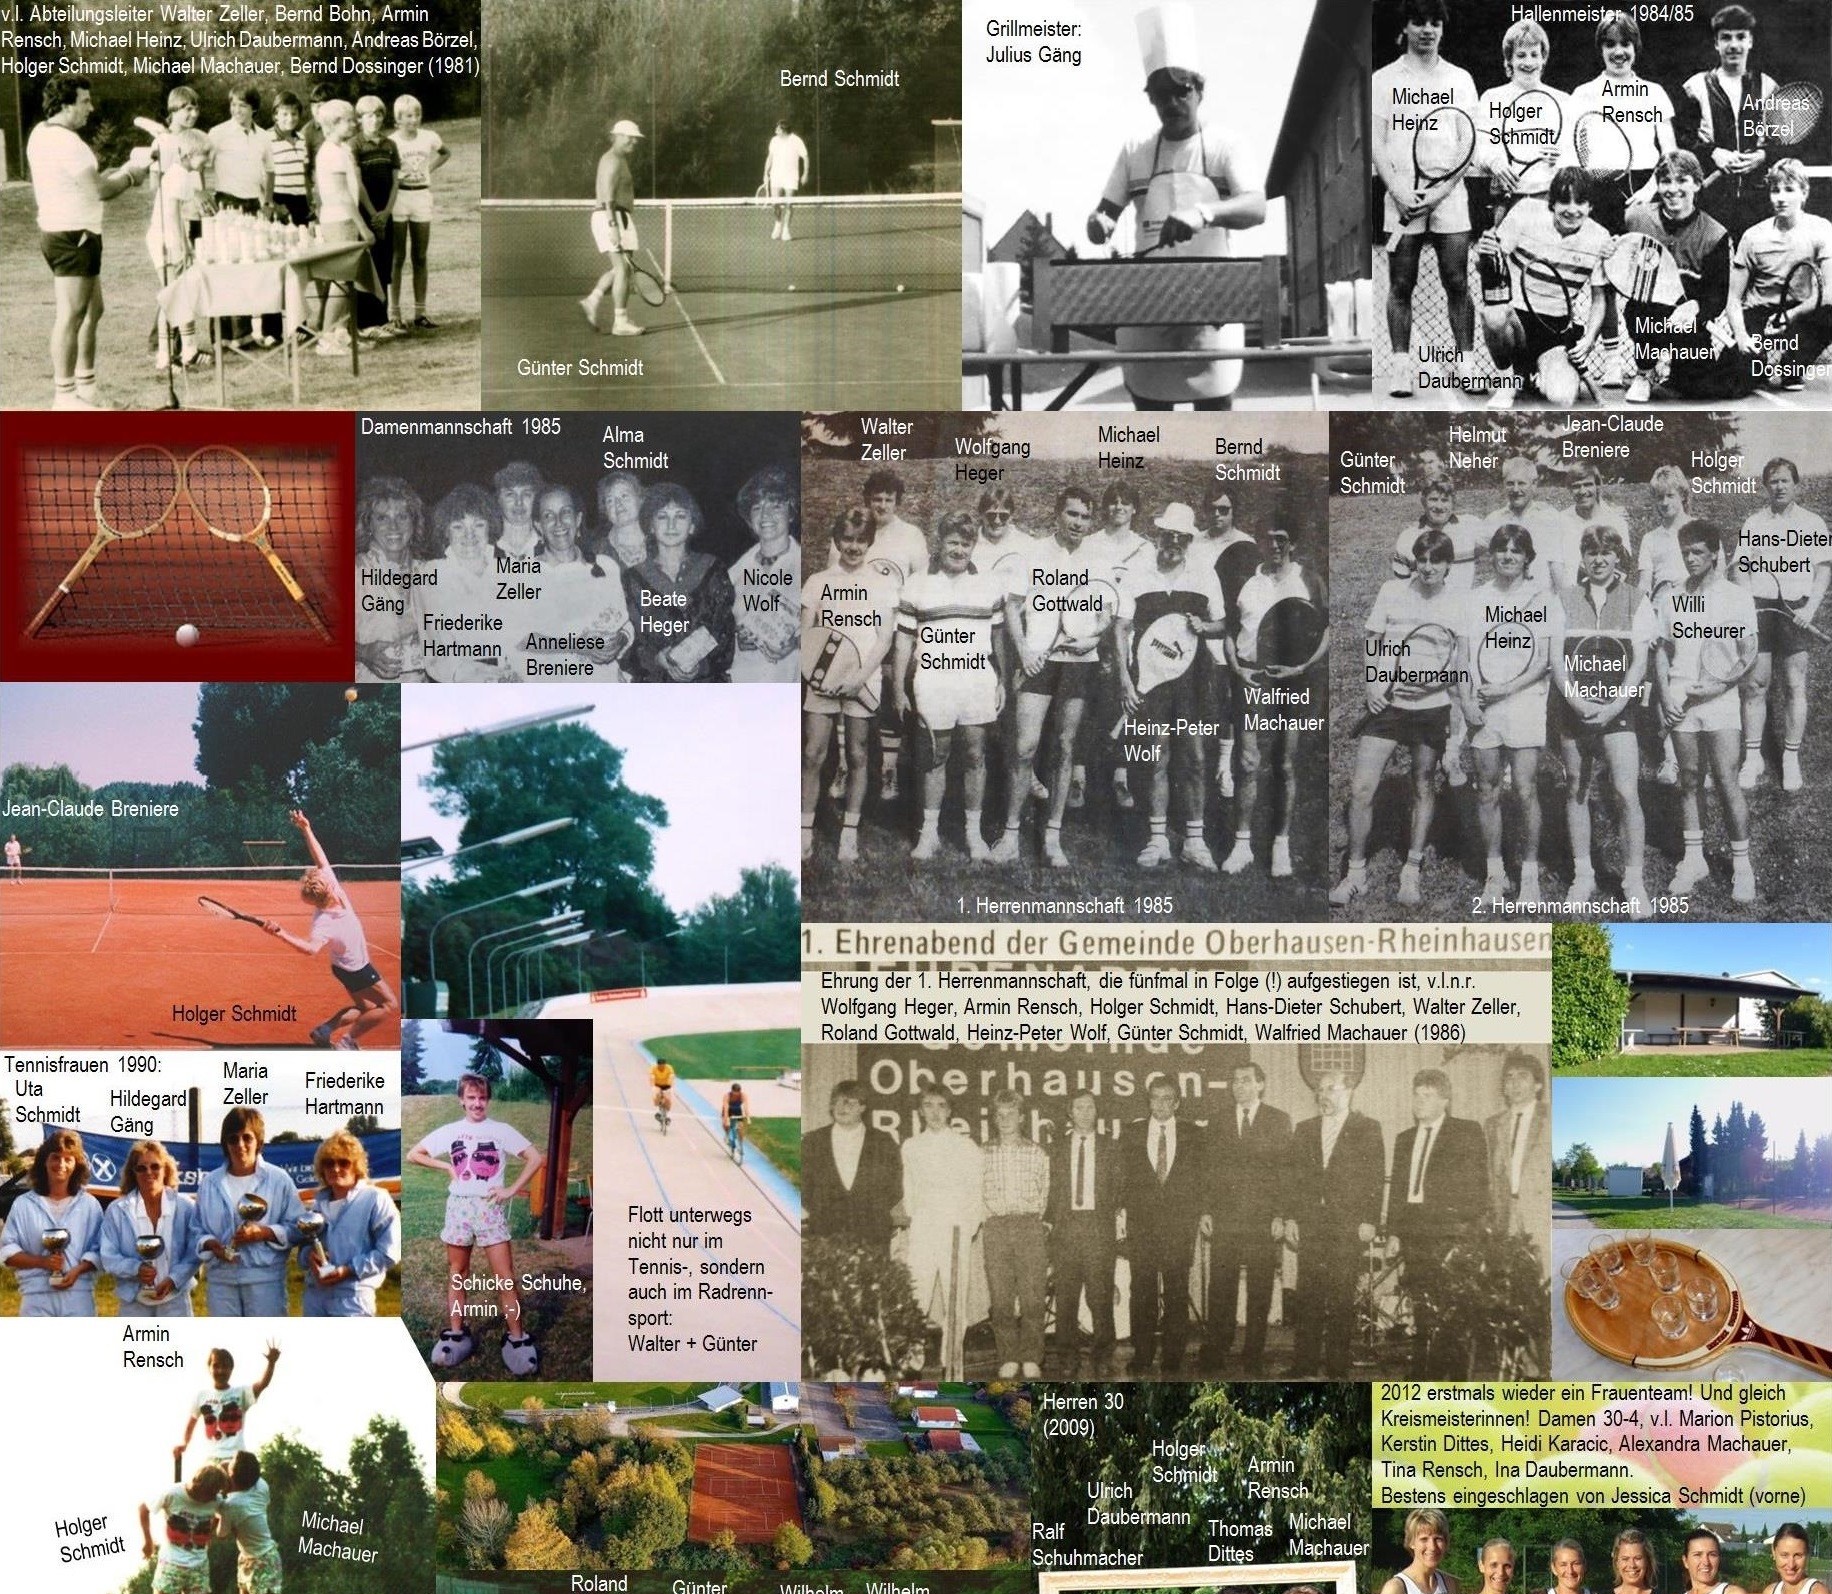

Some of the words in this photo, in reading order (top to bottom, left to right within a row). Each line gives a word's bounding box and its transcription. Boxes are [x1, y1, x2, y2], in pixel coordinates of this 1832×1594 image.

[803, 929, 823, 955] 1.
[837, 930, 996, 955] Ehrenabend
[1008, 930, 1049, 955] der
[1059, 930, 1194, 955] Gemeinde
[1206, 927, 1553, 954] Oberhausen-Rheinhausen
